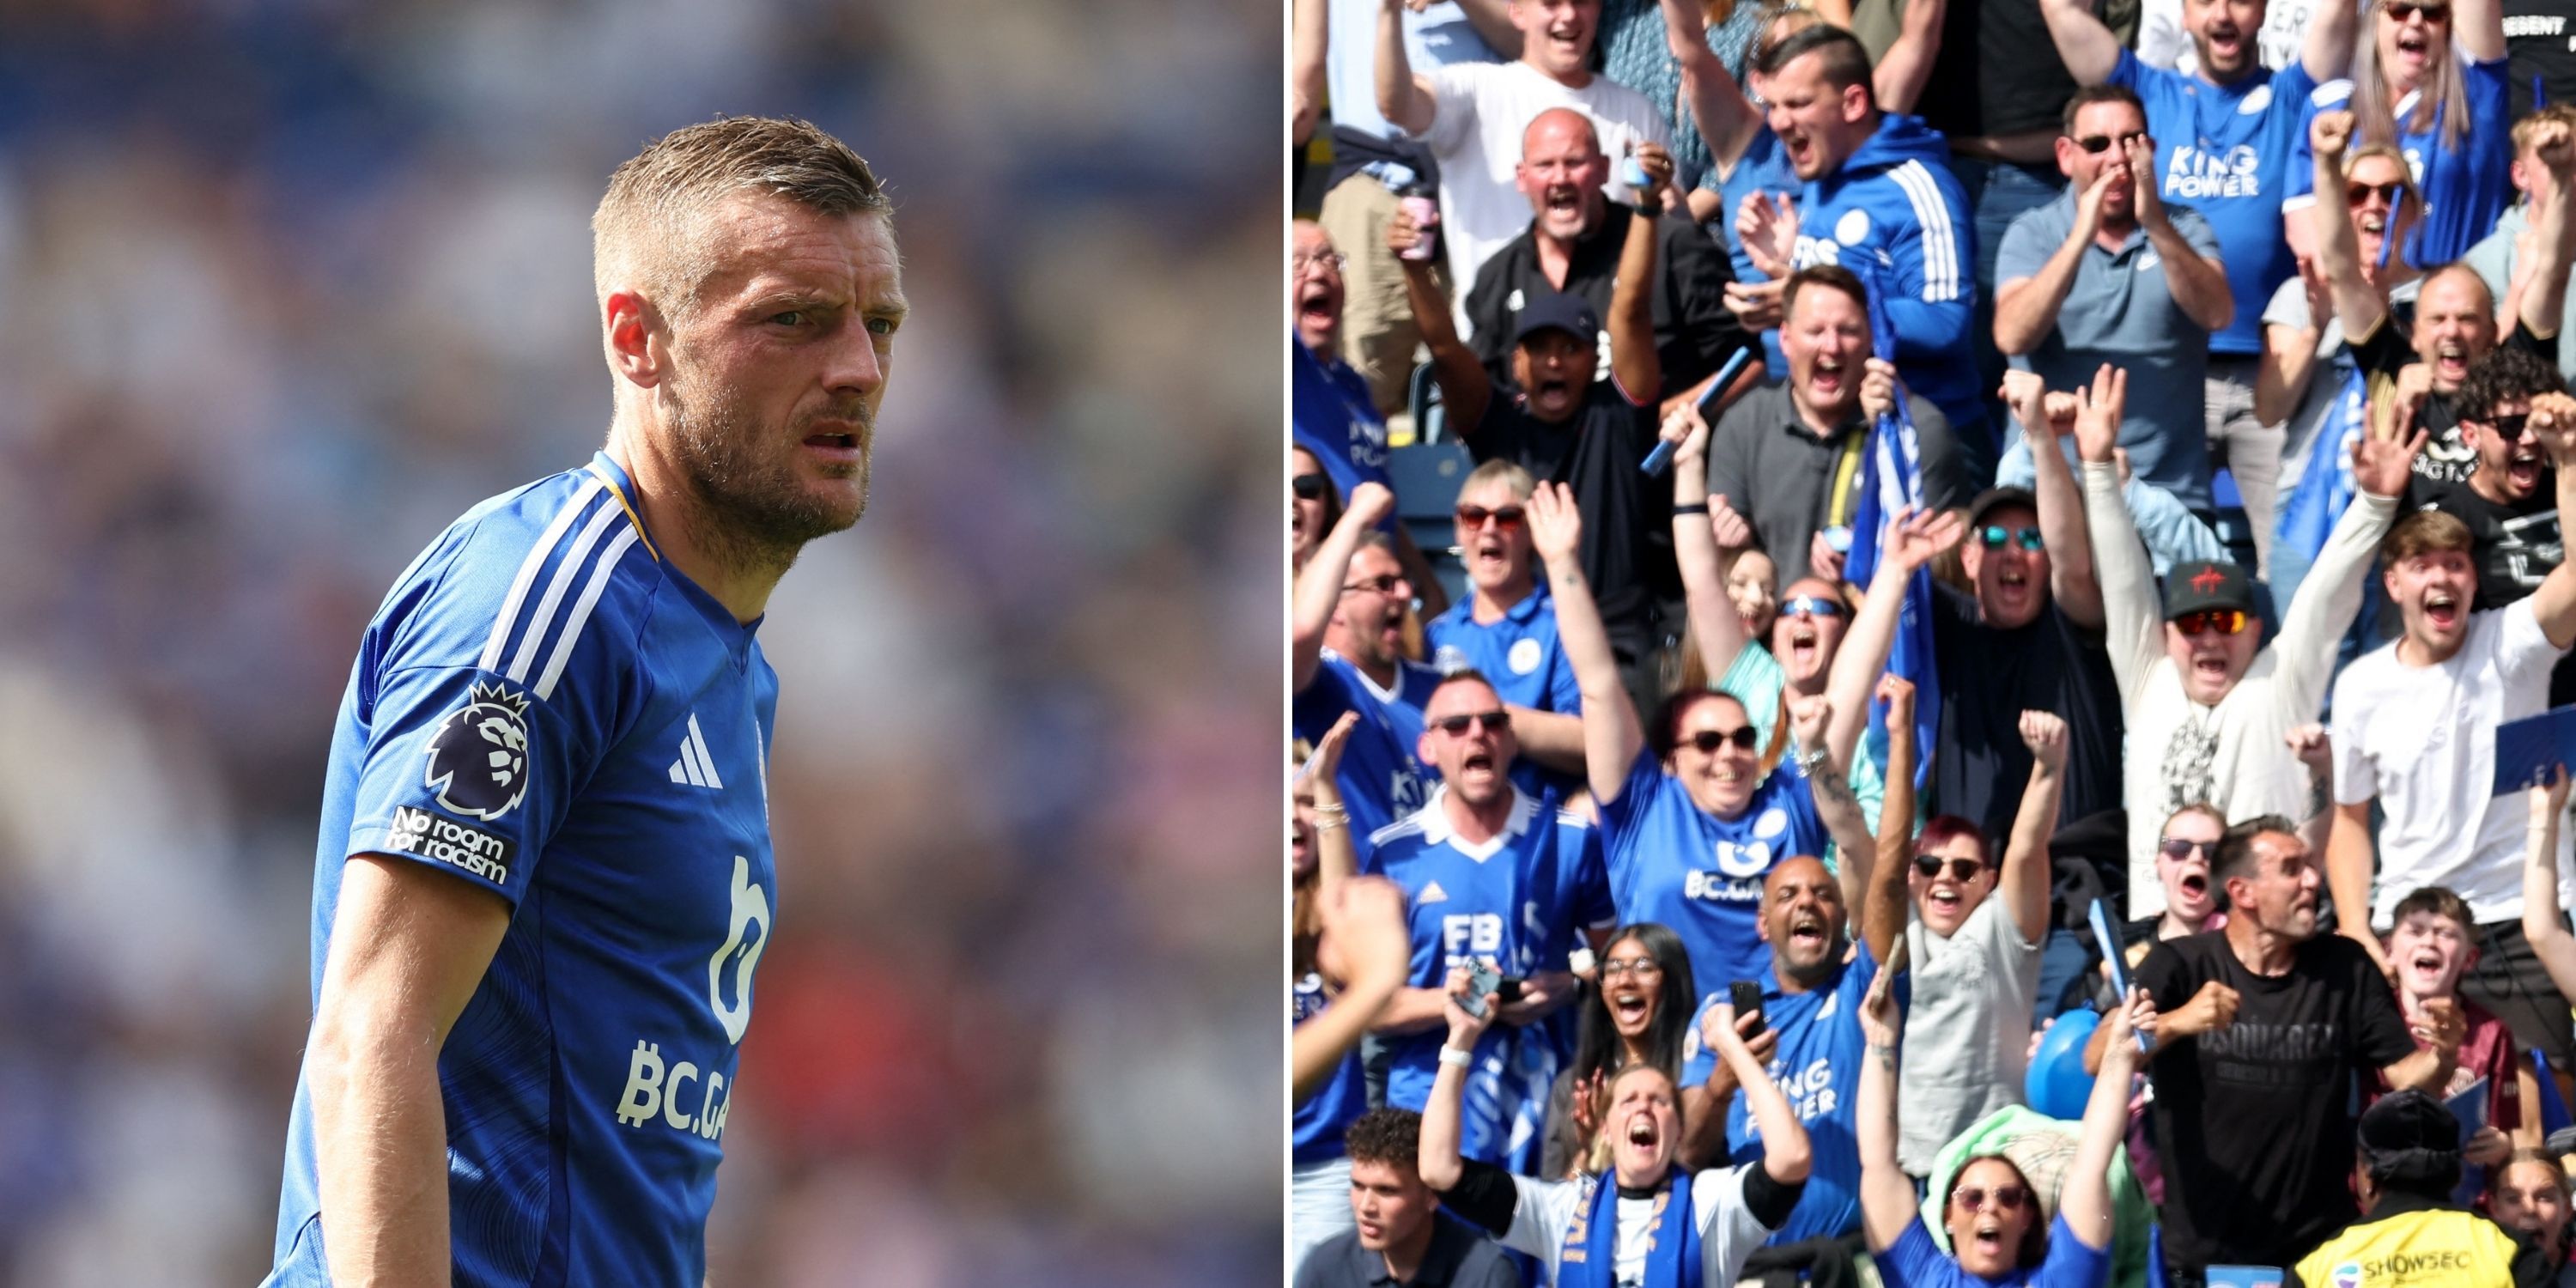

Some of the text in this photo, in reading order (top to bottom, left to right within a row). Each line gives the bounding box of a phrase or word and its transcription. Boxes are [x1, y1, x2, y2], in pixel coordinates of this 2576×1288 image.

[2169, 144, 2259, 177] KING
[2165, 173, 2260, 198] POWER
[392, 805, 505, 860] No room
[385, 826, 507, 885] for racism
[2364, 1251, 2470, 1279] SHOWSEC
